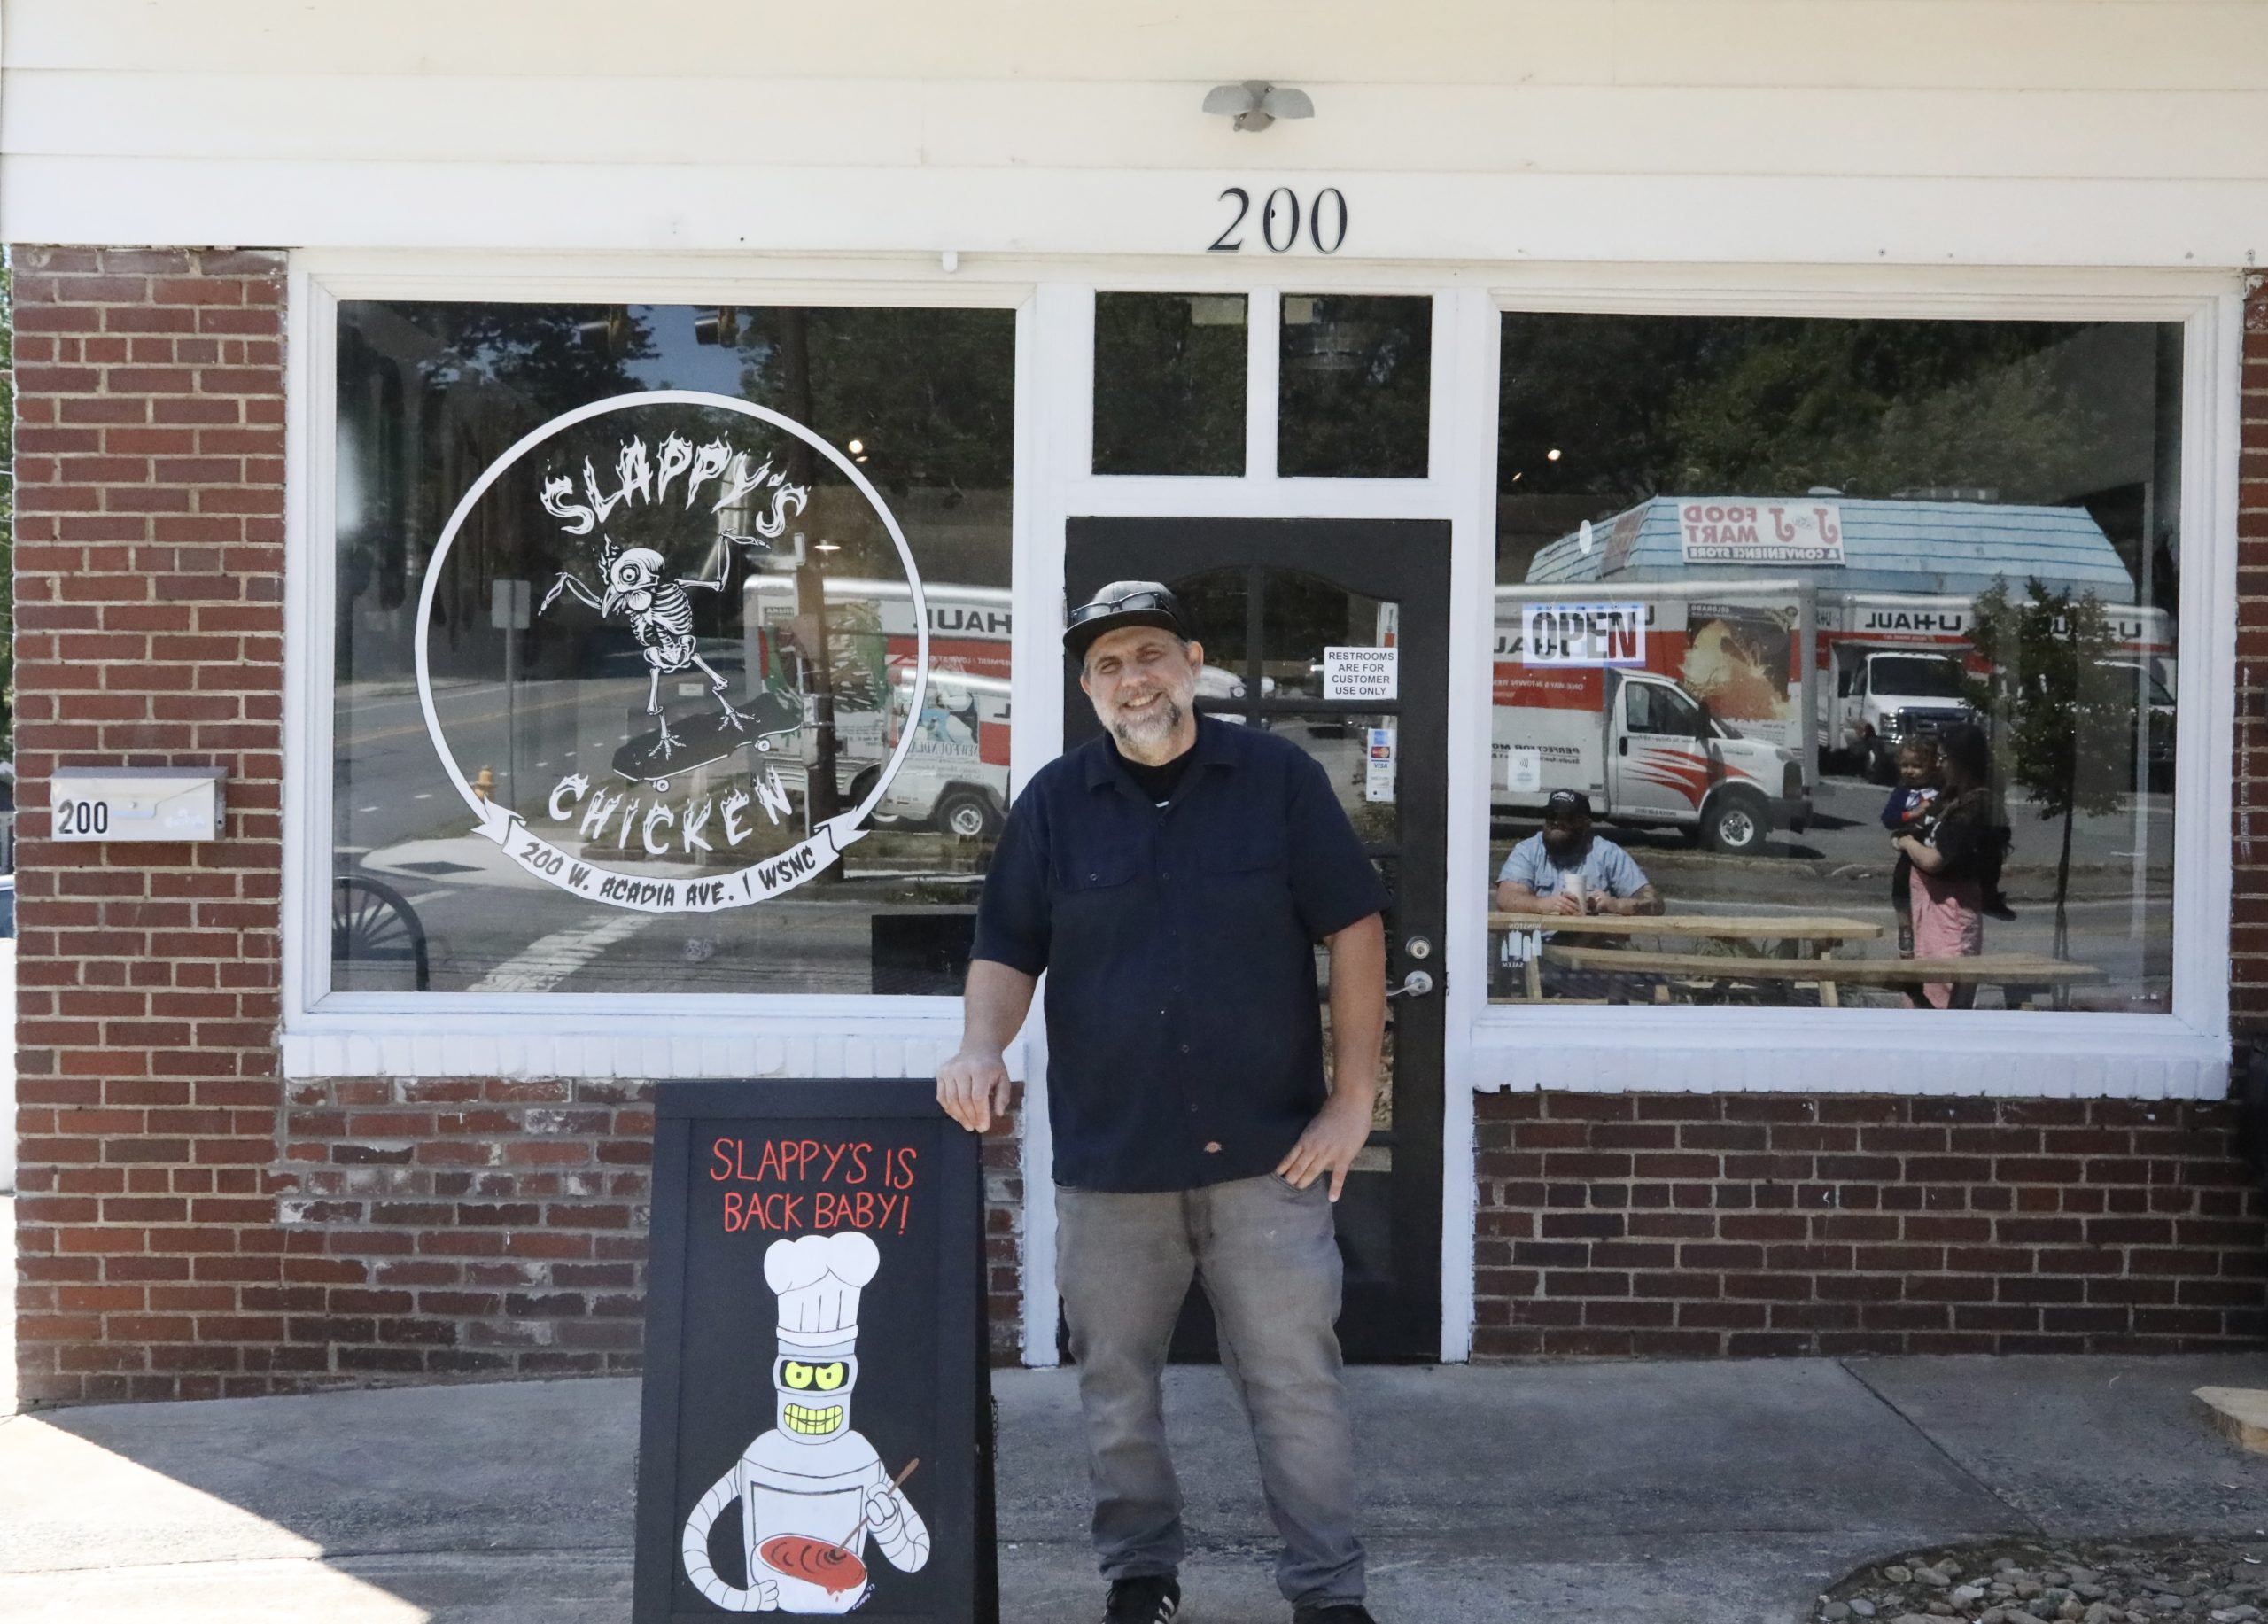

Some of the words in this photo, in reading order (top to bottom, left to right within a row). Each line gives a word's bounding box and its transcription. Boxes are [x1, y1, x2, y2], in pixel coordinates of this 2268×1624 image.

[1206, 187, 1348, 254] 200
[540, 431, 811, 537] SLAPPY'S
[1329, 651, 1394, 661] RESTROOMS
[1532, 611, 1637, 660] OPEN
[1332, 675, 1390, 684] CUSTOMER
[1339, 664, 1360, 672] ARE
[1363, 664, 1384, 672] FOR
[1359, 687, 1386, 695] ONLY
[58, 799, 108, 834] 200
[549, 766, 792, 855] CHICKEN
[520, 842, 563, 875] 200
[568, 863, 591, 890] W.
[599, 876, 675, 906] ACADIA
[686, 880, 734, 906] AVE.
[758, 845, 816, 890] WSNC
[710, 1138, 873, 1184] SLAPPY'S
[885, 1147, 918, 1189] IS
[724, 1192, 804, 1232] BACK
[814, 1193, 910, 1236] BABY!
